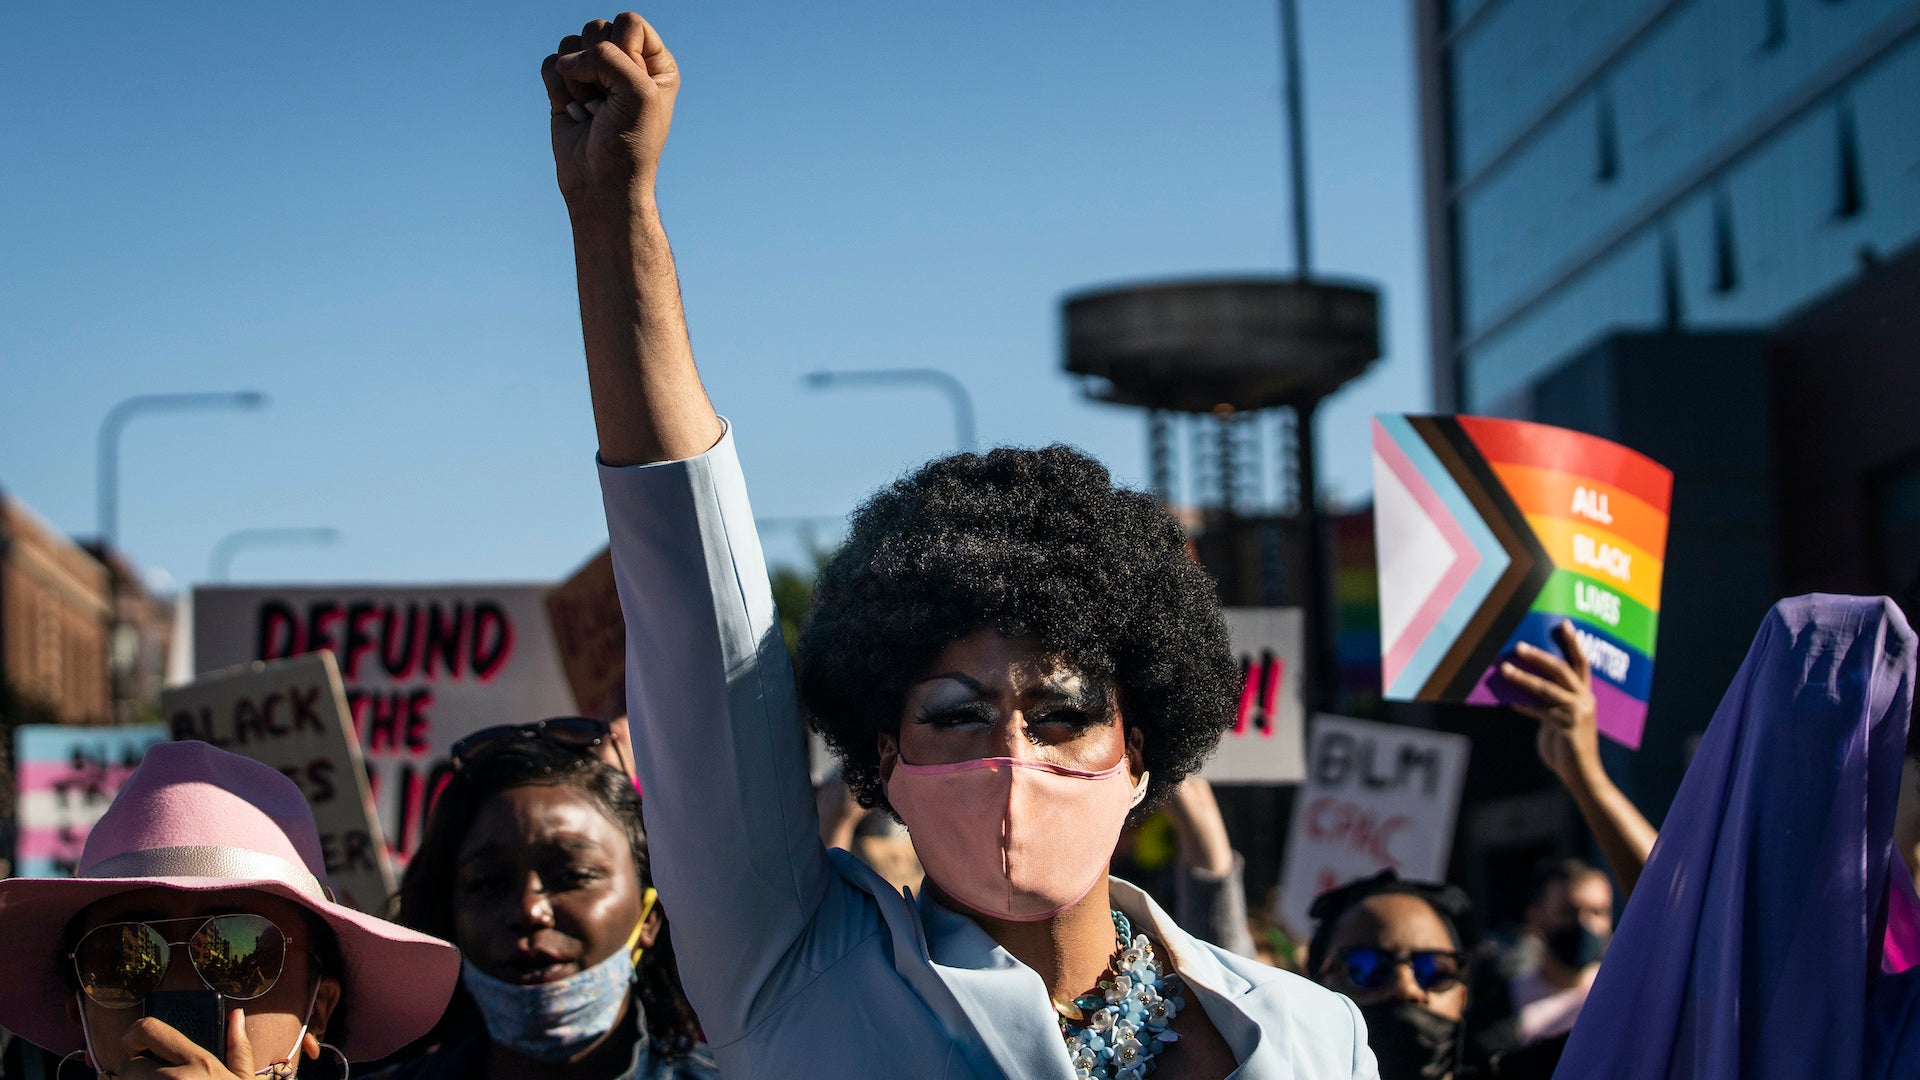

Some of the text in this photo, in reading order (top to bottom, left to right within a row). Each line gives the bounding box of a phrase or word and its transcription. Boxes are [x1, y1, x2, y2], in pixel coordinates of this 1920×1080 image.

[1571, 486, 1613, 524] ALL
[1573, 533, 1632, 582] BLACK
[1575, 580, 1621, 626] LIVES
[257, 598, 516, 686] DEFUND
[171, 684, 326, 745] BLACK
[346, 686, 436, 757] THE
[1314, 730, 1441, 799] BLM
